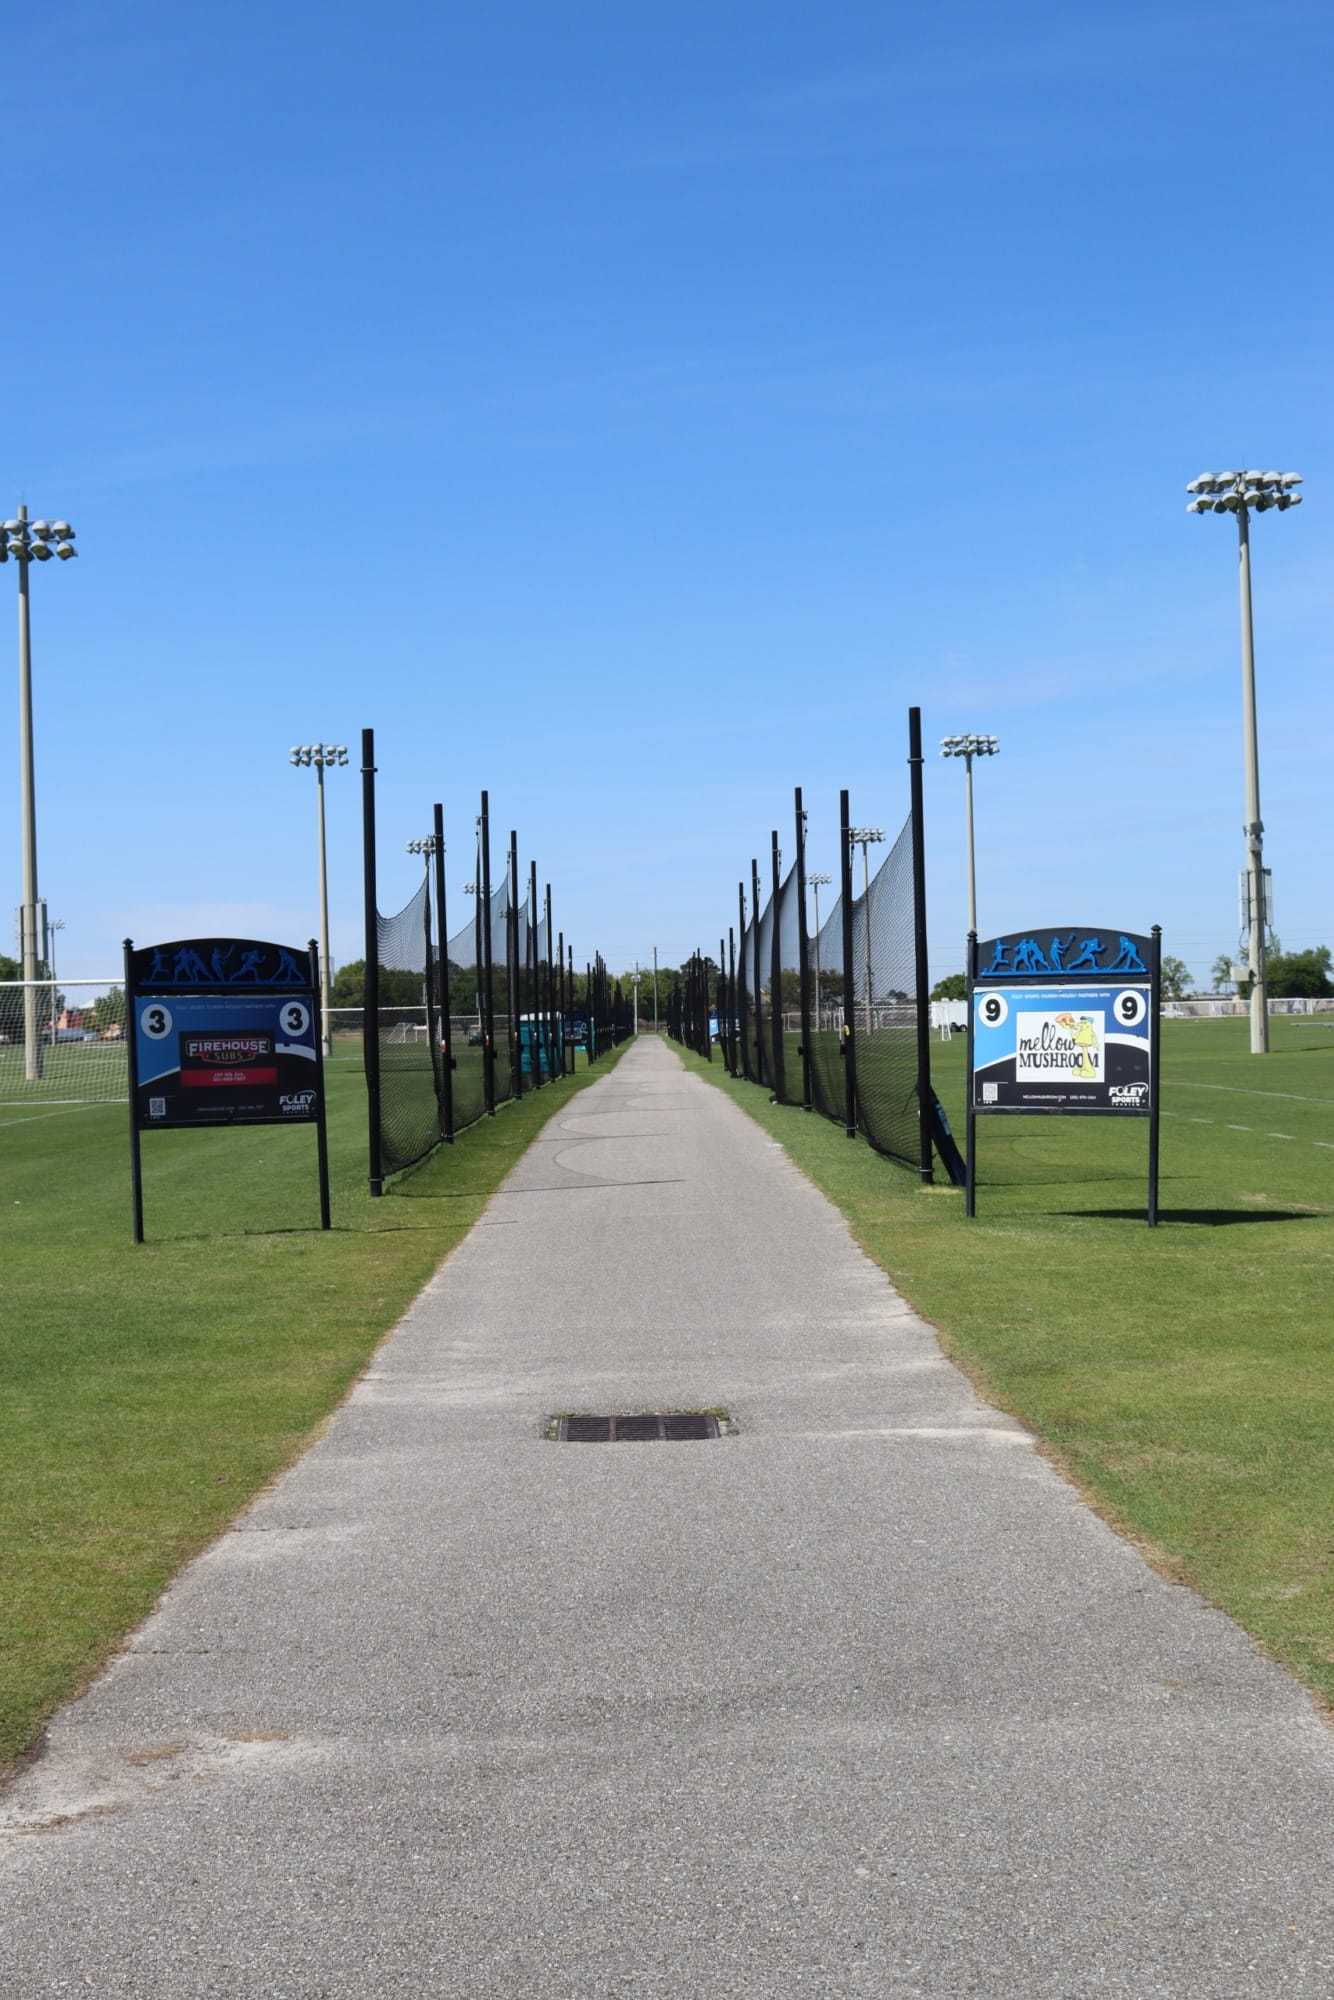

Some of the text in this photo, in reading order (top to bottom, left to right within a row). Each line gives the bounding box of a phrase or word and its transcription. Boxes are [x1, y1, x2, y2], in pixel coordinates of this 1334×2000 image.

[985, 998, 1001, 1022] 9
[1121, 996, 1138, 1021] 9
[149, 1010, 165, 1034] 3
[287, 1008, 303, 1031] 3
[1019, 1021, 1076, 1052] mellow
[189, 1041, 267, 1056] FIREHOUSE
[214, 1051, 243, 1061] SUBS
[1019, 1052, 1099, 1068] MUSHROOM
[280, 1094, 314, 1105] FOLEY
[1108, 1086, 1145, 1097] FOLEY
